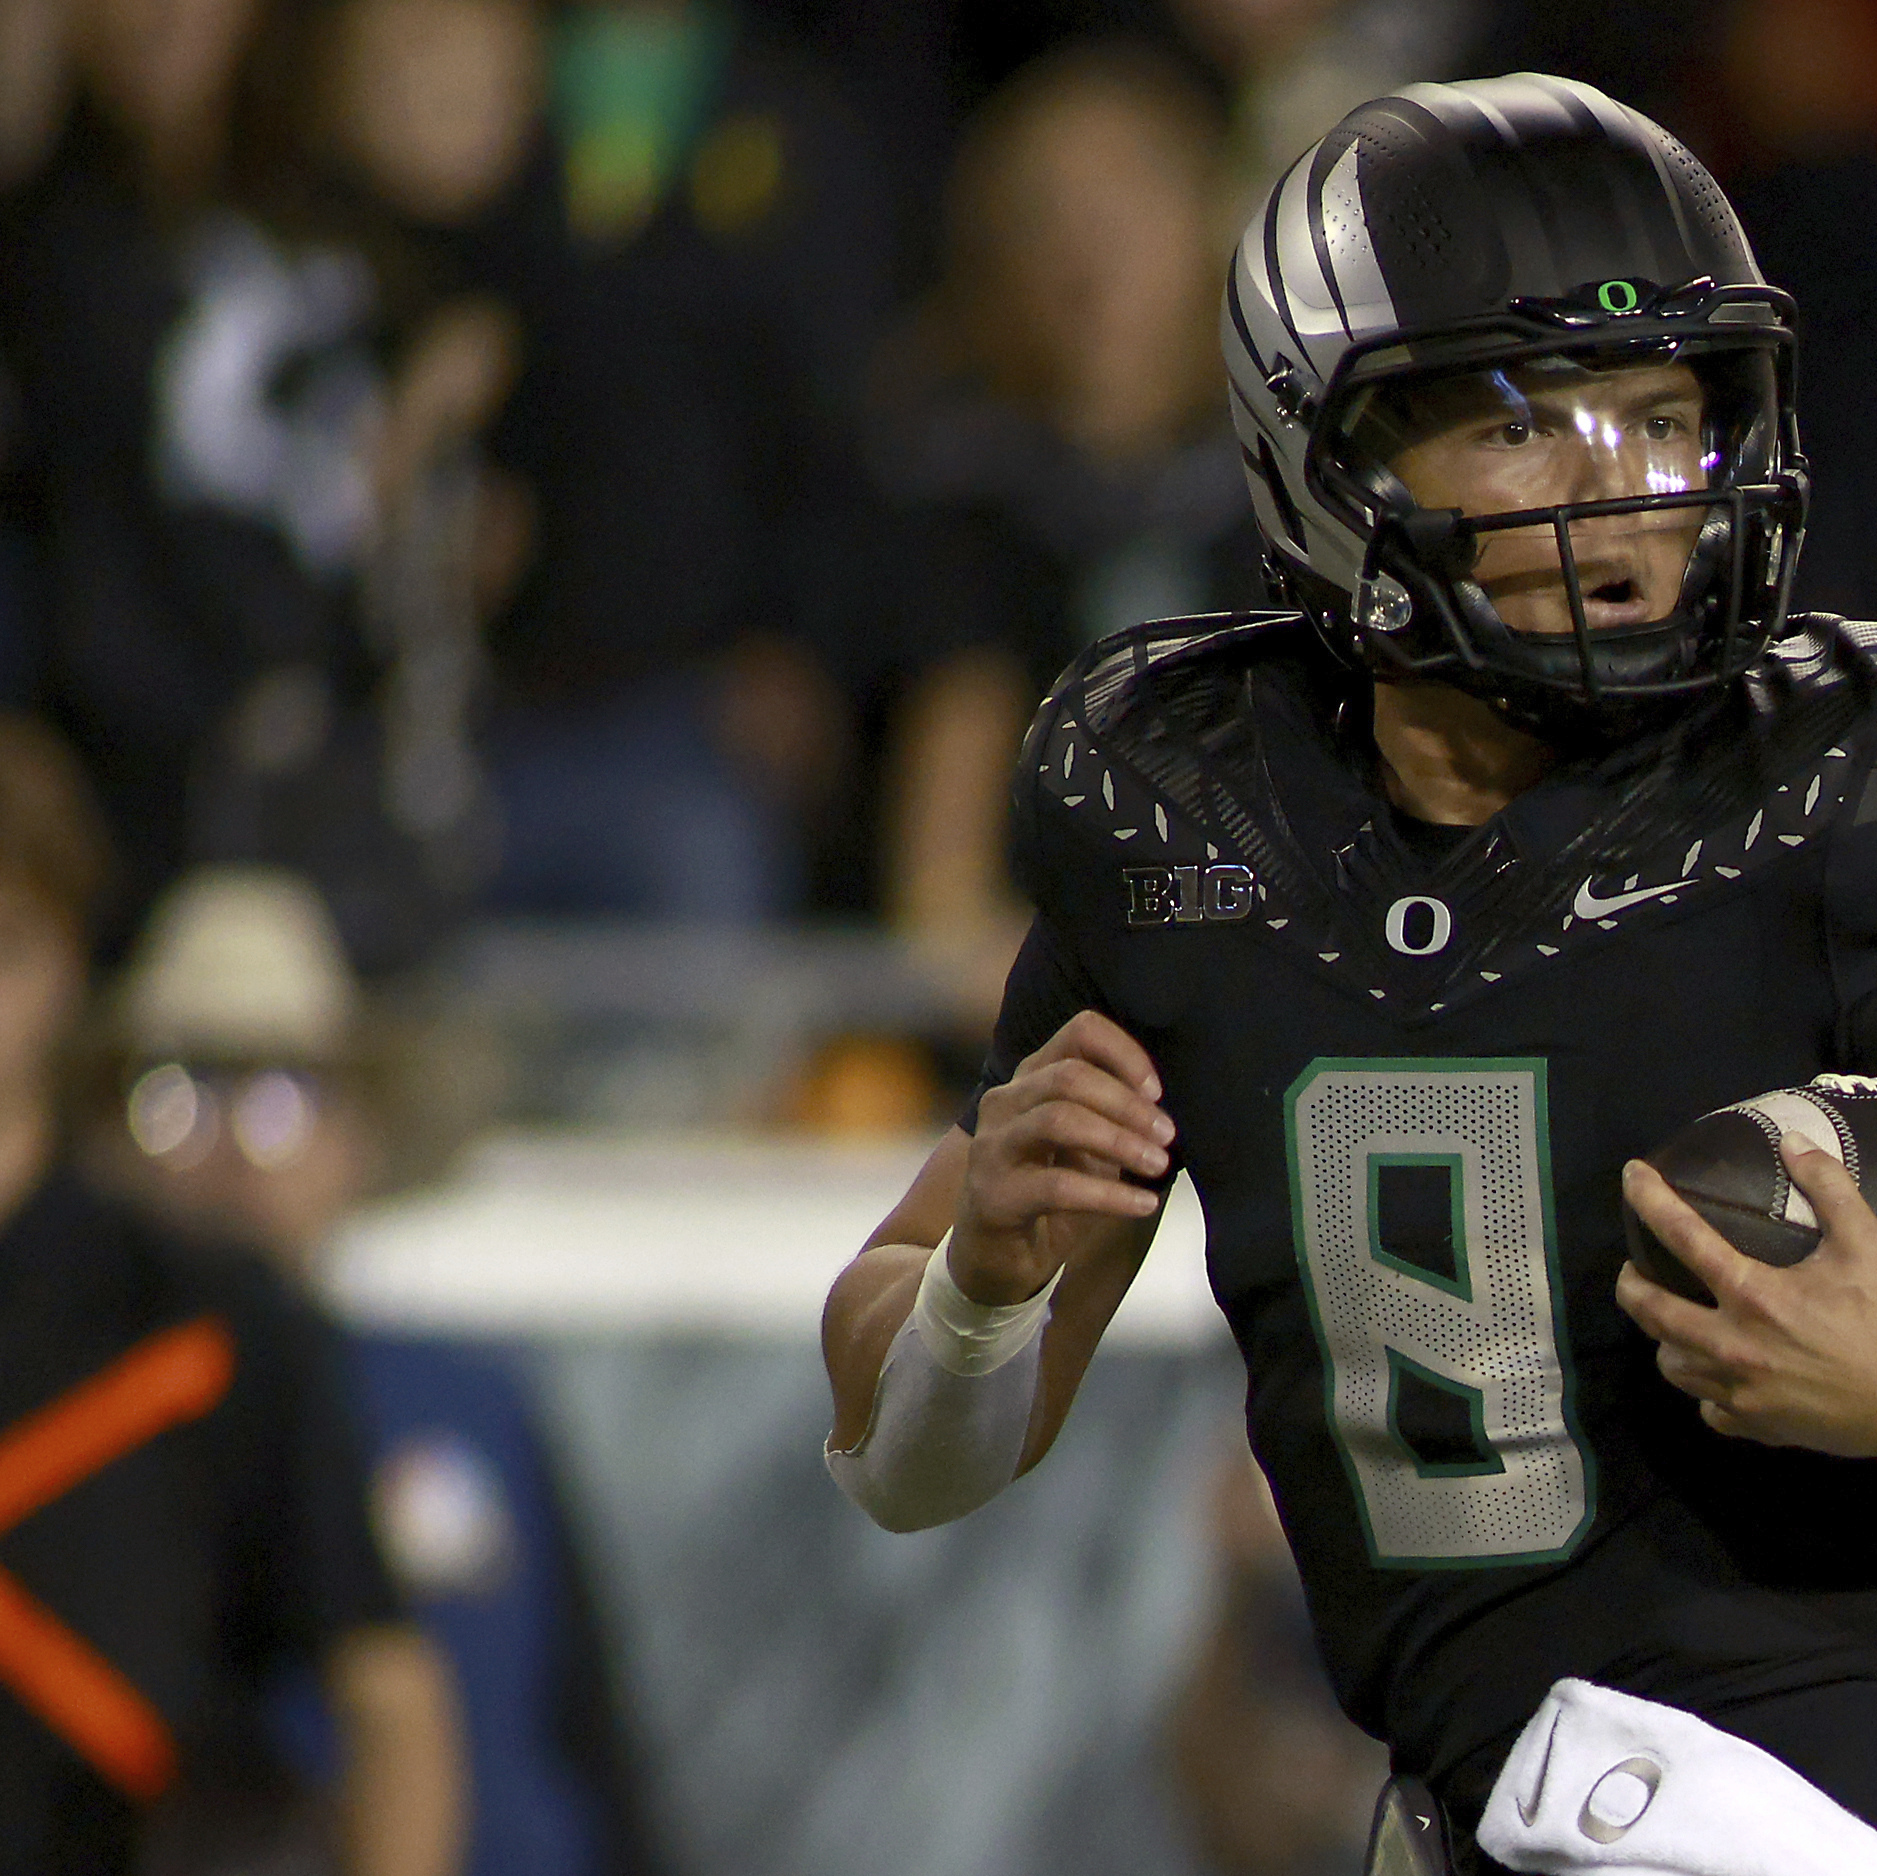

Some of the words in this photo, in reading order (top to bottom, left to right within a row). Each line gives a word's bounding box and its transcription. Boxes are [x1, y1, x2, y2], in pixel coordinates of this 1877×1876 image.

[1598, 281, 1637, 312] O
[1385, 895, 1451, 955] O
[1283, 1057, 1596, 1569] 8
